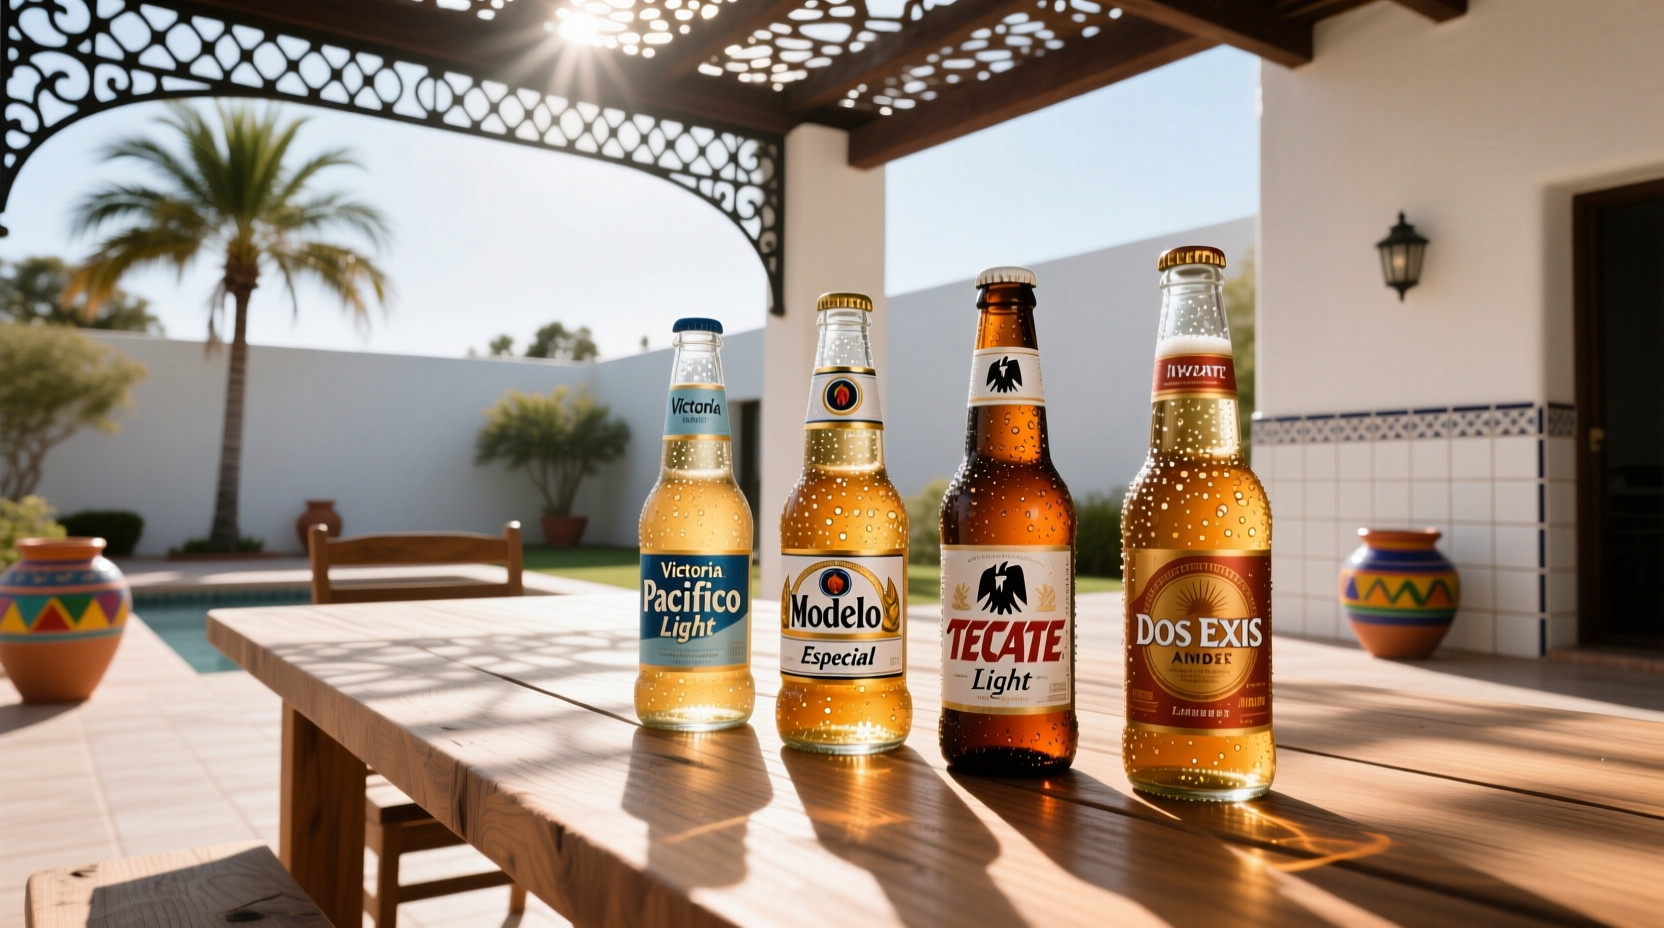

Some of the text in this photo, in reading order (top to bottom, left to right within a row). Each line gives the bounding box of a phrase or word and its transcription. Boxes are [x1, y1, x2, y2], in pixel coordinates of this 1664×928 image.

[643, 579, 741, 613] Pacifico
[791, 594, 882, 629] Modelo
[660, 614, 717, 644] Light
[946, 618, 1066, 663] TECATE
[1136, 613, 1263, 648] DOS EXIS
[801, 646, 876, 671] Especial
[971, 667, 1033, 699] Light
